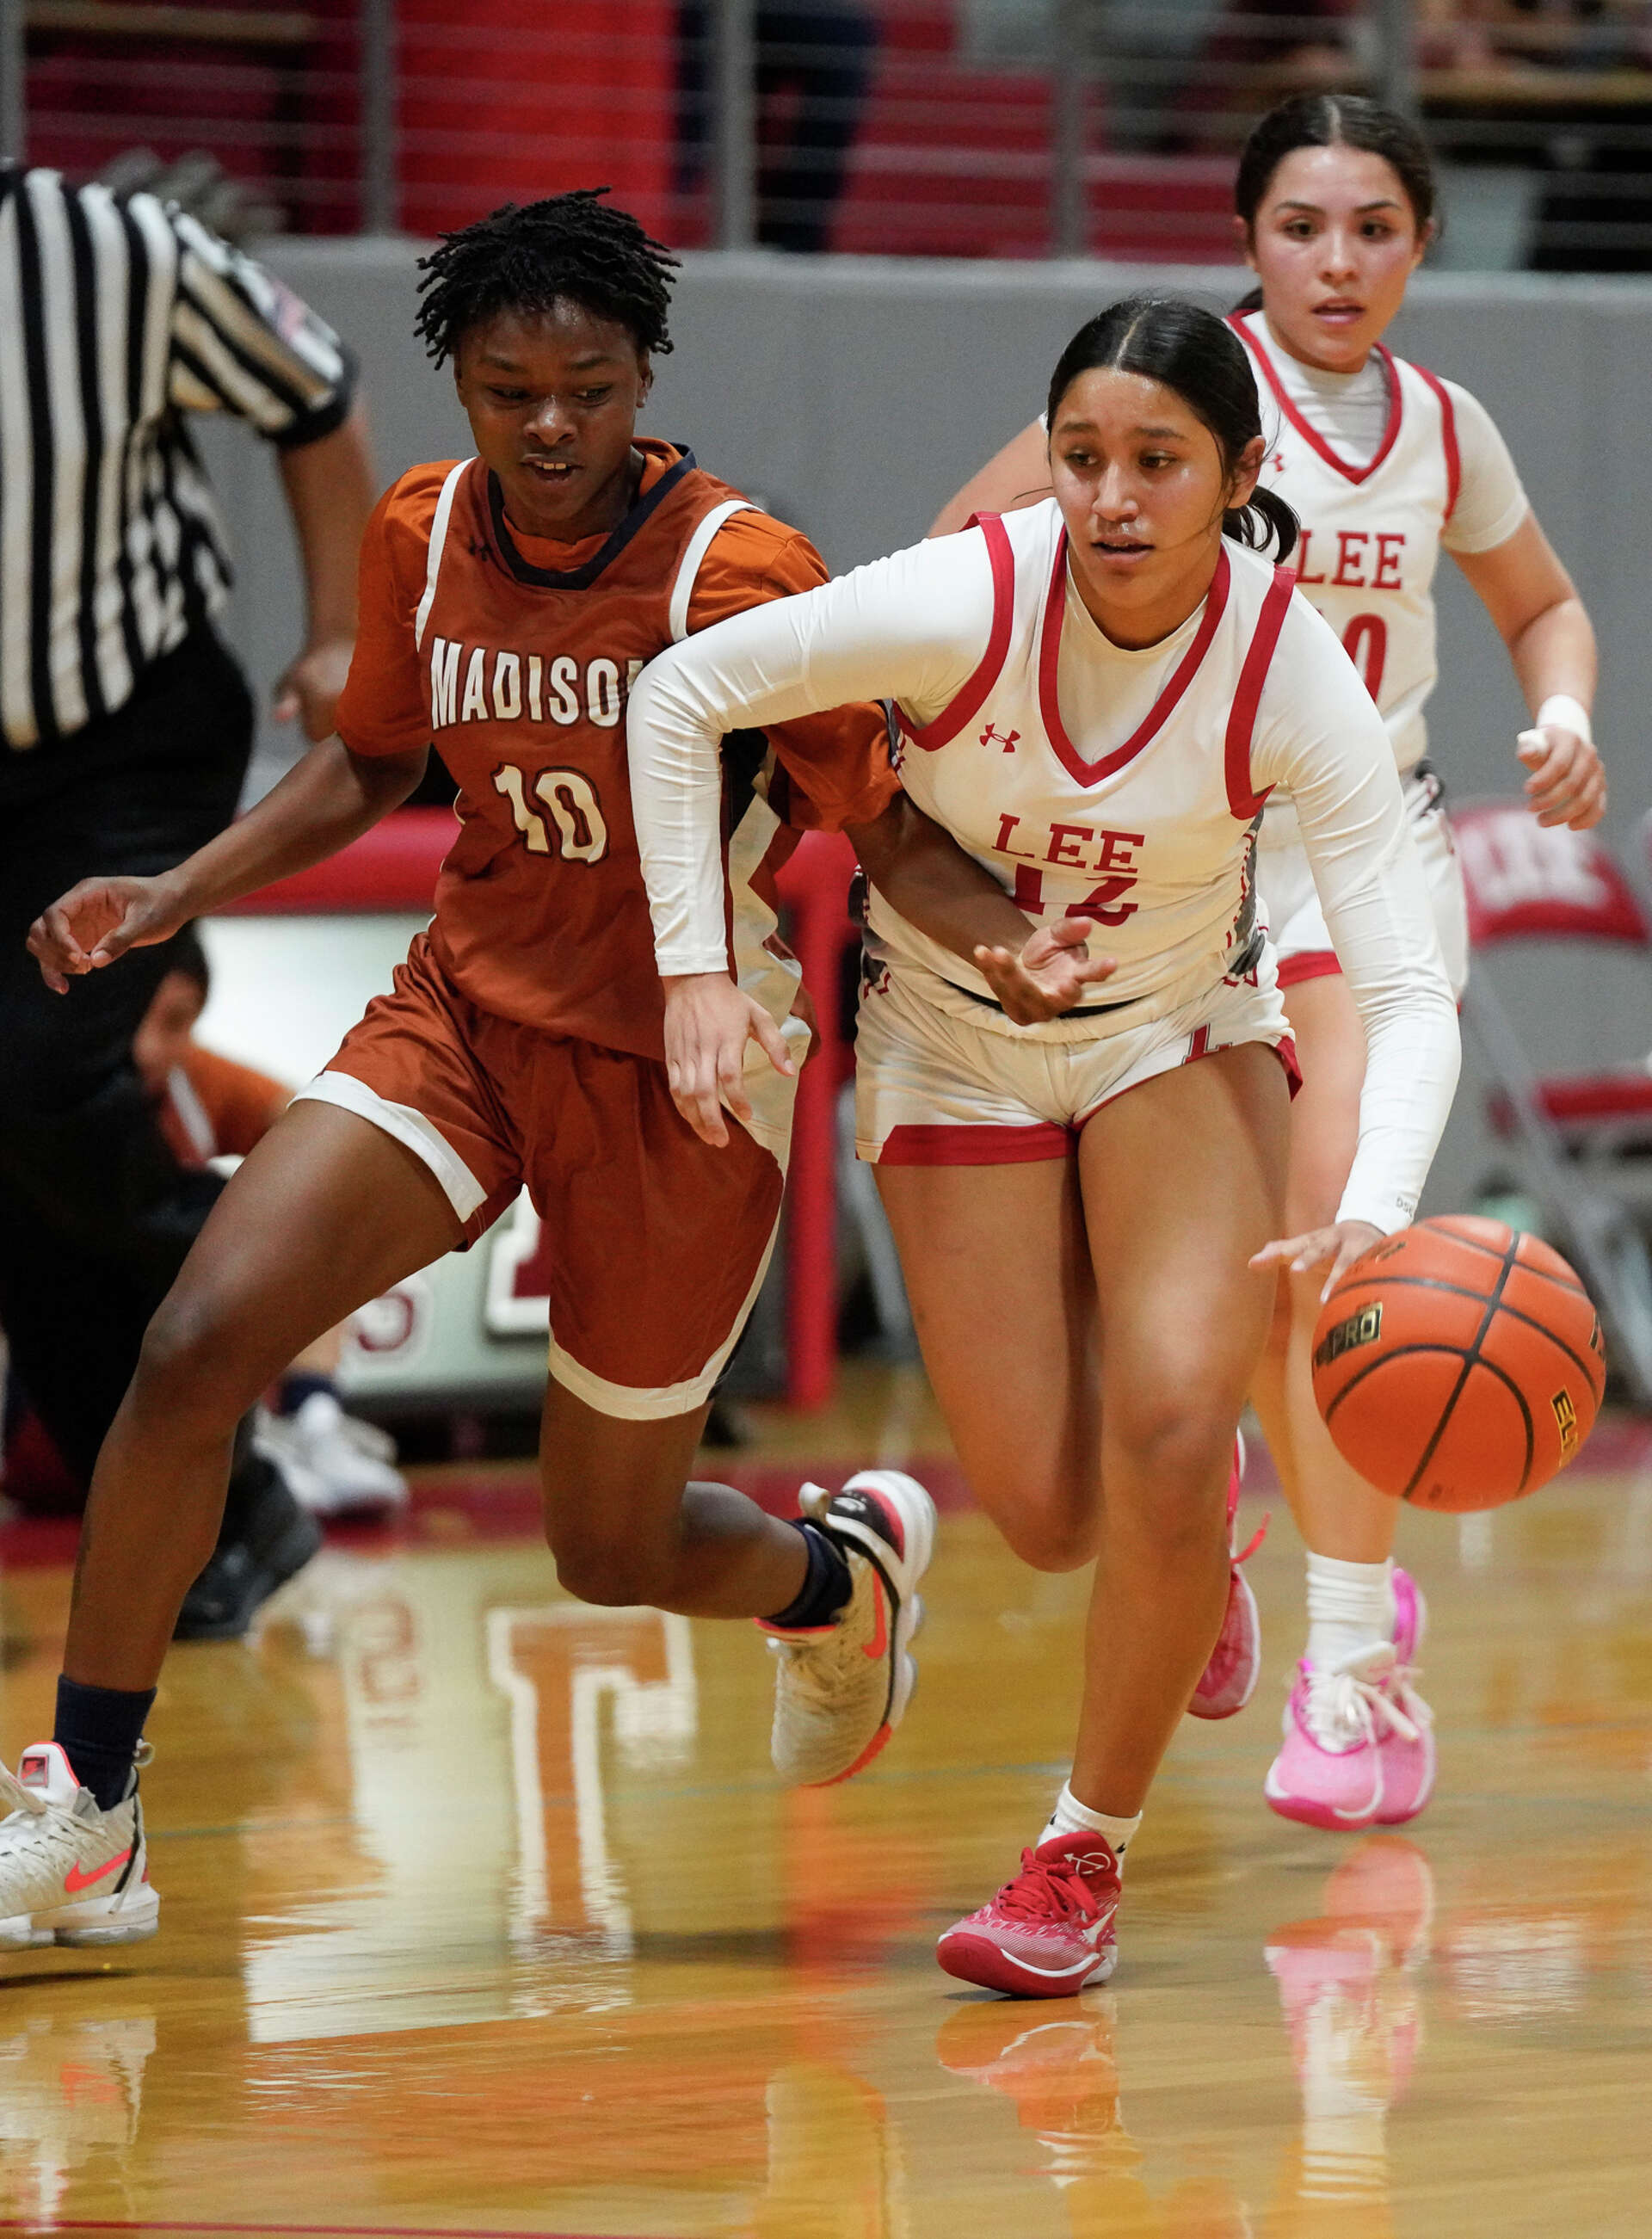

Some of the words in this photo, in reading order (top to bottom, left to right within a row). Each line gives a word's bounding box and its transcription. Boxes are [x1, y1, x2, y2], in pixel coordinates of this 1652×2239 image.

[1295, 529, 1406, 590] LEE
[430, 637, 644, 730] MADISO
[492, 763, 607, 864] 10
[991, 812, 1145, 874] LEE
[1013, 862, 1139, 928] 12
[1332, 1310, 1377, 1358] PRO
